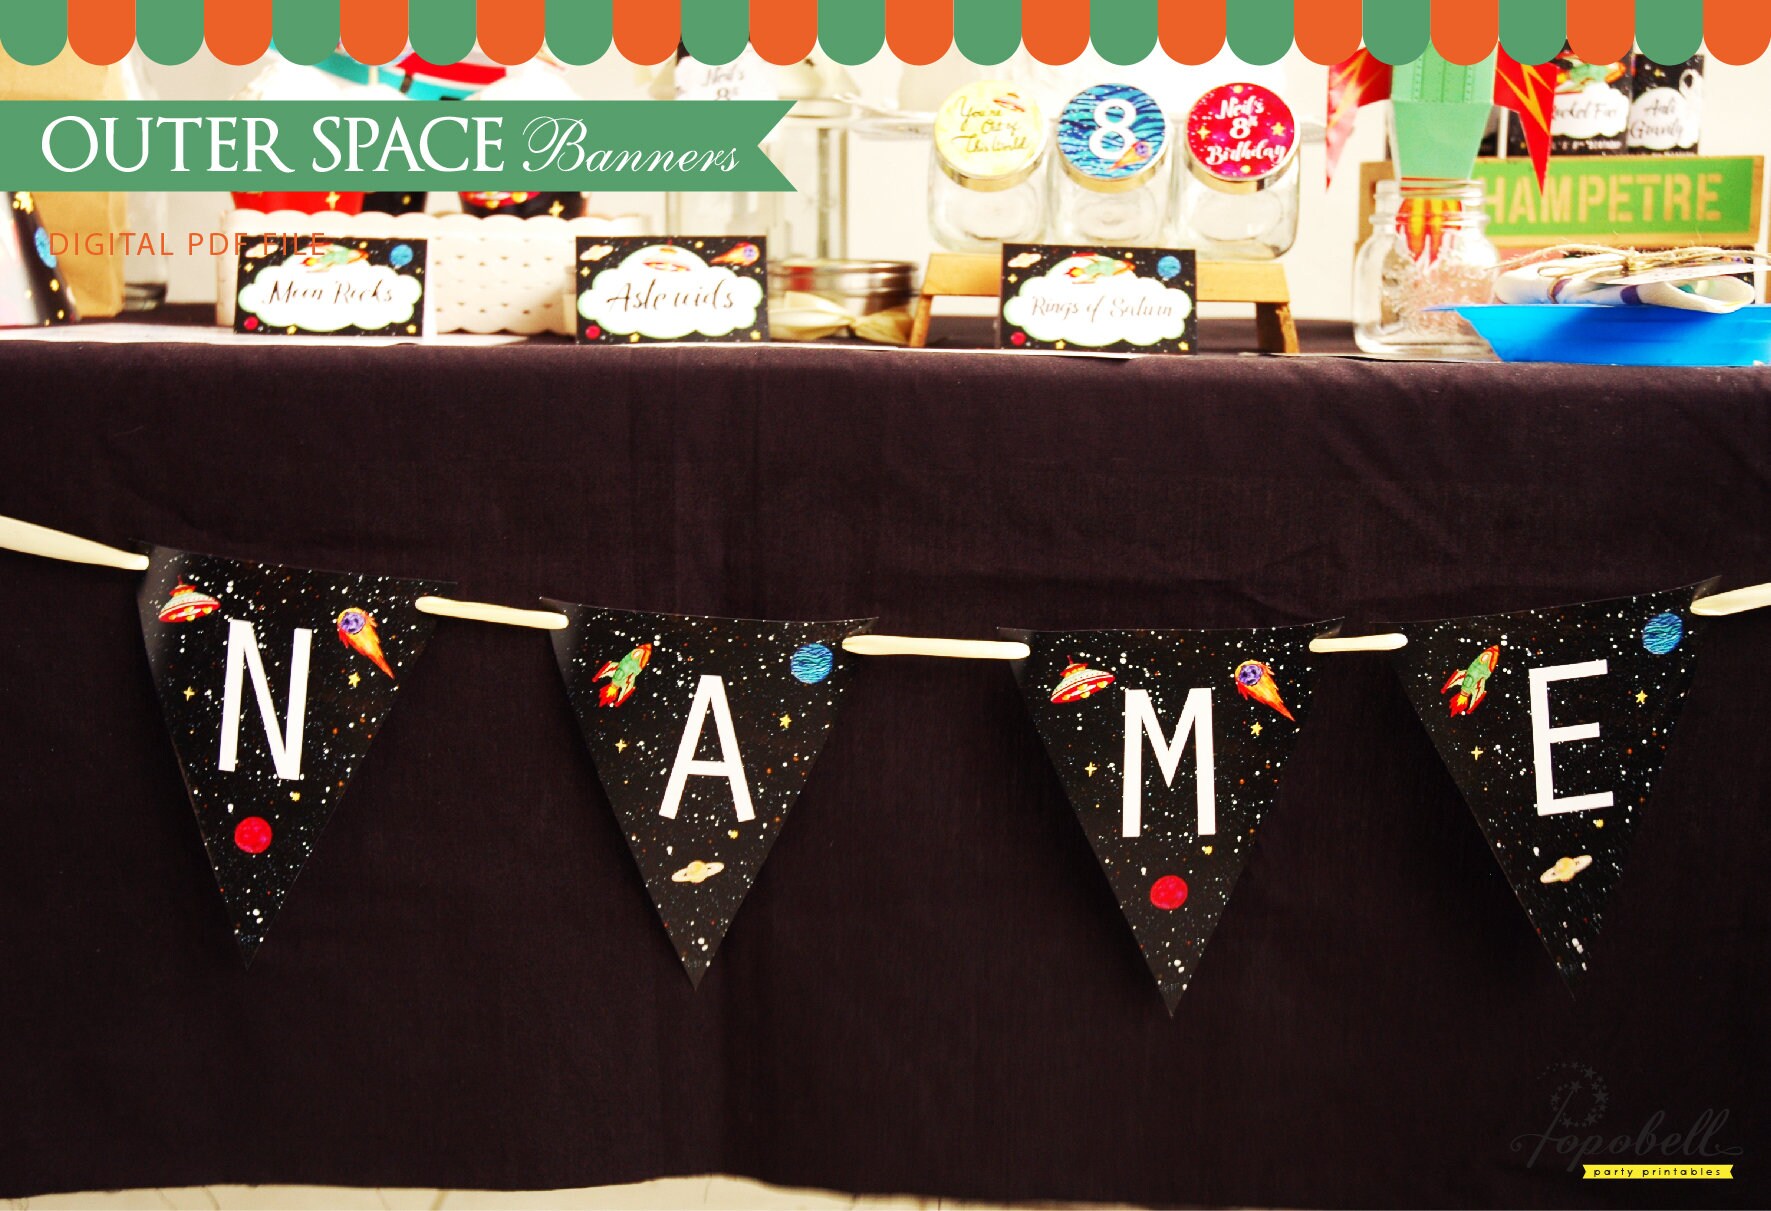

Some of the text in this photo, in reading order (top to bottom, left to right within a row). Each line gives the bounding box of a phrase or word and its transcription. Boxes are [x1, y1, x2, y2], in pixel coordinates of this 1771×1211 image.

[1088, 97, 1137, 160] 8
[1205, 138, 1286, 166] Birthday
[1031, 296, 1079, 320] Rings
[218, 619, 312, 781] N
[658, 674, 756, 823] A
[1122, 687, 1216, 838] M
[1528, 659, 1614, 816] E
